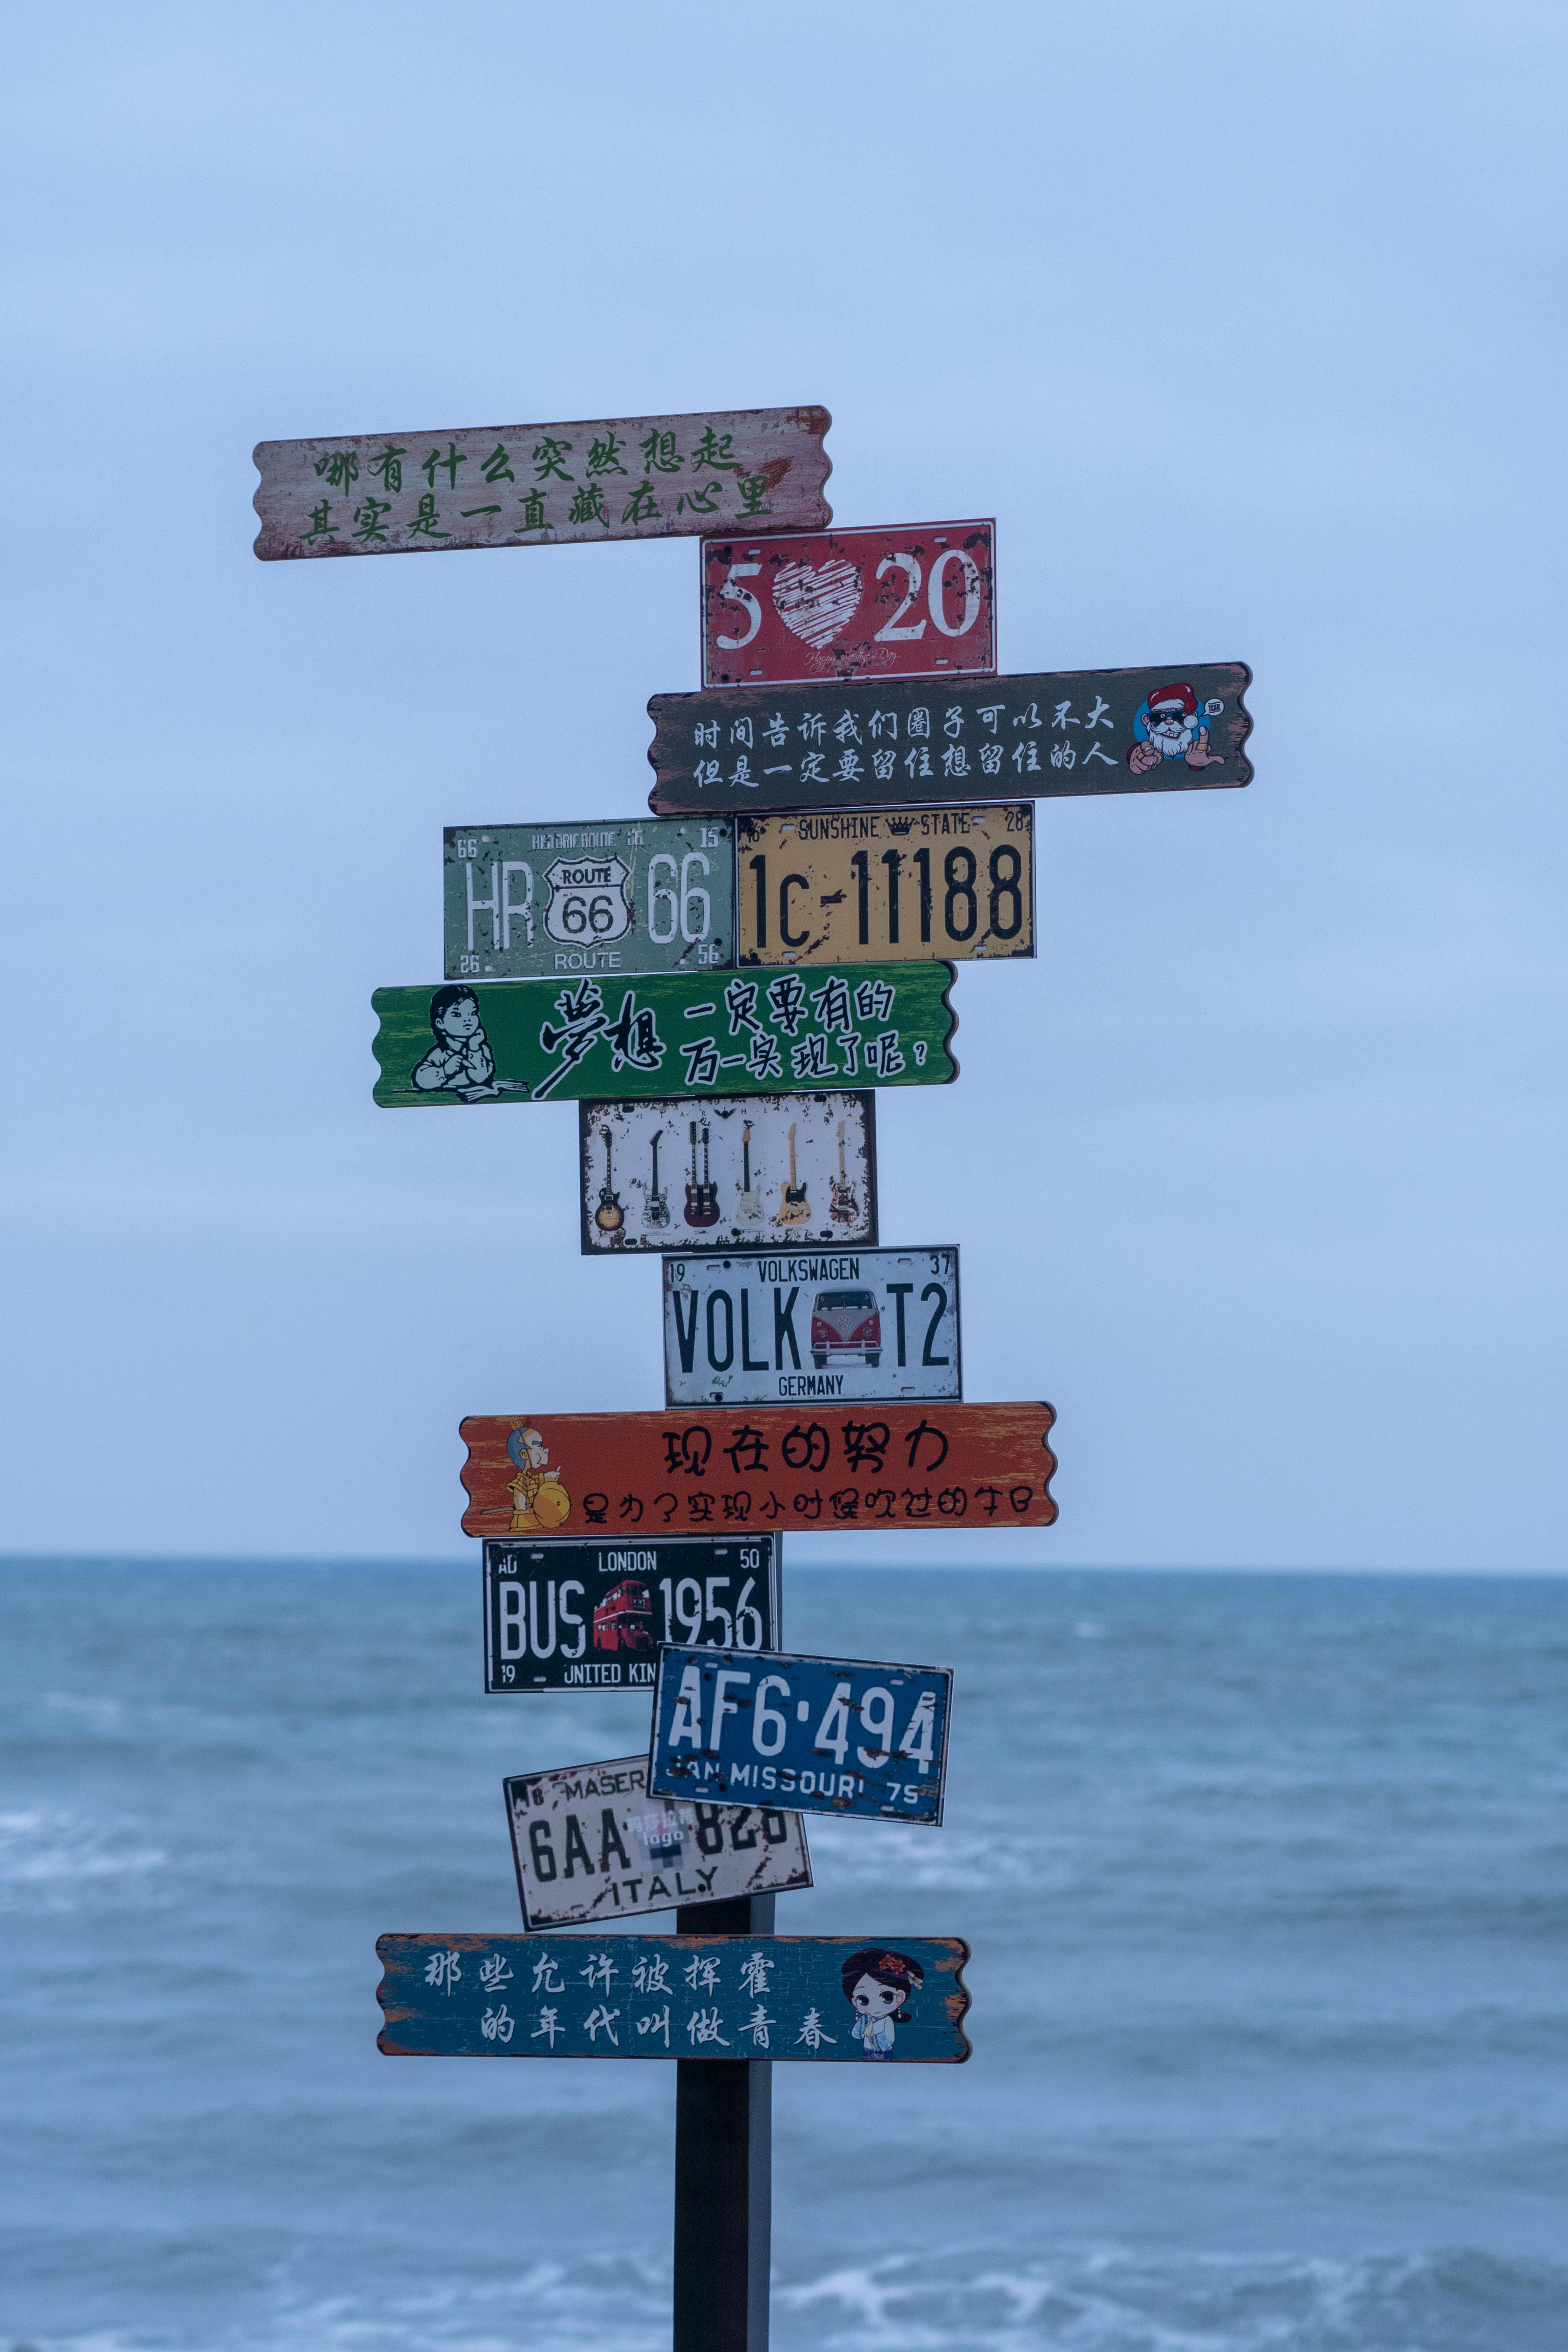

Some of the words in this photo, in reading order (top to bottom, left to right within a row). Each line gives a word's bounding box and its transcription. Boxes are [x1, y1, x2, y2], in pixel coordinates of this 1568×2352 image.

[316, 426, 742, 497] 哪有什么突然想起
[298, 474, 773, 545] 其实是一直藏在心里
[717, 563, 762, 650] 5
[874, 549, 980, 642] 20
[694, 696, 1114, 749] 时间告诉我们圈子可以不大
[693, 740, 1118, 788] 但是一定要留住想留住的人
[799, 816, 879, 840] SUNSHINE
[921, 813, 971, 835] STATE
[1006, 811, 1024, 832] 28
[457, 839, 477, 858] 66
[532, 833, 580, 849] HISTORIC
[581, 832, 616, 848] ROUTE
[700, 826, 719, 848] 15
[562, 867, 612, 884] ROUTE
[466, 861, 534, 951] HR
[648, 852, 711, 944] 66
[562, 895, 614, 934] 66
[460, 955, 479, 973] 26
[555, 952, 621, 970] ROUTE
[698, 945, 719, 964] 56
[684, 975, 895, 1036] 一定要有的
[670, 1263, 685, 1283] 19
[757, 1258, 860, 1283] VOLKSWAGEN
[930, 1255, 950, 1275] 37
[673, 1287, 802, 1373] VOLK
[886, 1282, 949, 1367] T2
[779, 1375, 844, 1396] GERMANY
[661, 1419, 949, 1475] 现在的努力
[499, 1555, 517, 1574] AD
[599, 1551, 657, 1572] LONDON
[740, 1549, 759, 1568] 50
[499, 1580, 586, 1660] BUS
[659, 1577, 762, 1650] 1956
[501, 1665, 515, 1683] 19
[564, 1663, 621, 1684] UNITED
[730, 1763, 864, 1799] MISSOURI
[529, 1808, 631, 1882] 6AA
[643, 1831, 684, 1847] logo
[612, 1867, 719, 1906] ITALY
[423, 1951, 775, 1997] 那些允许被挥霍
[481, 2004, 838, 2051] 的年代叫做青春
